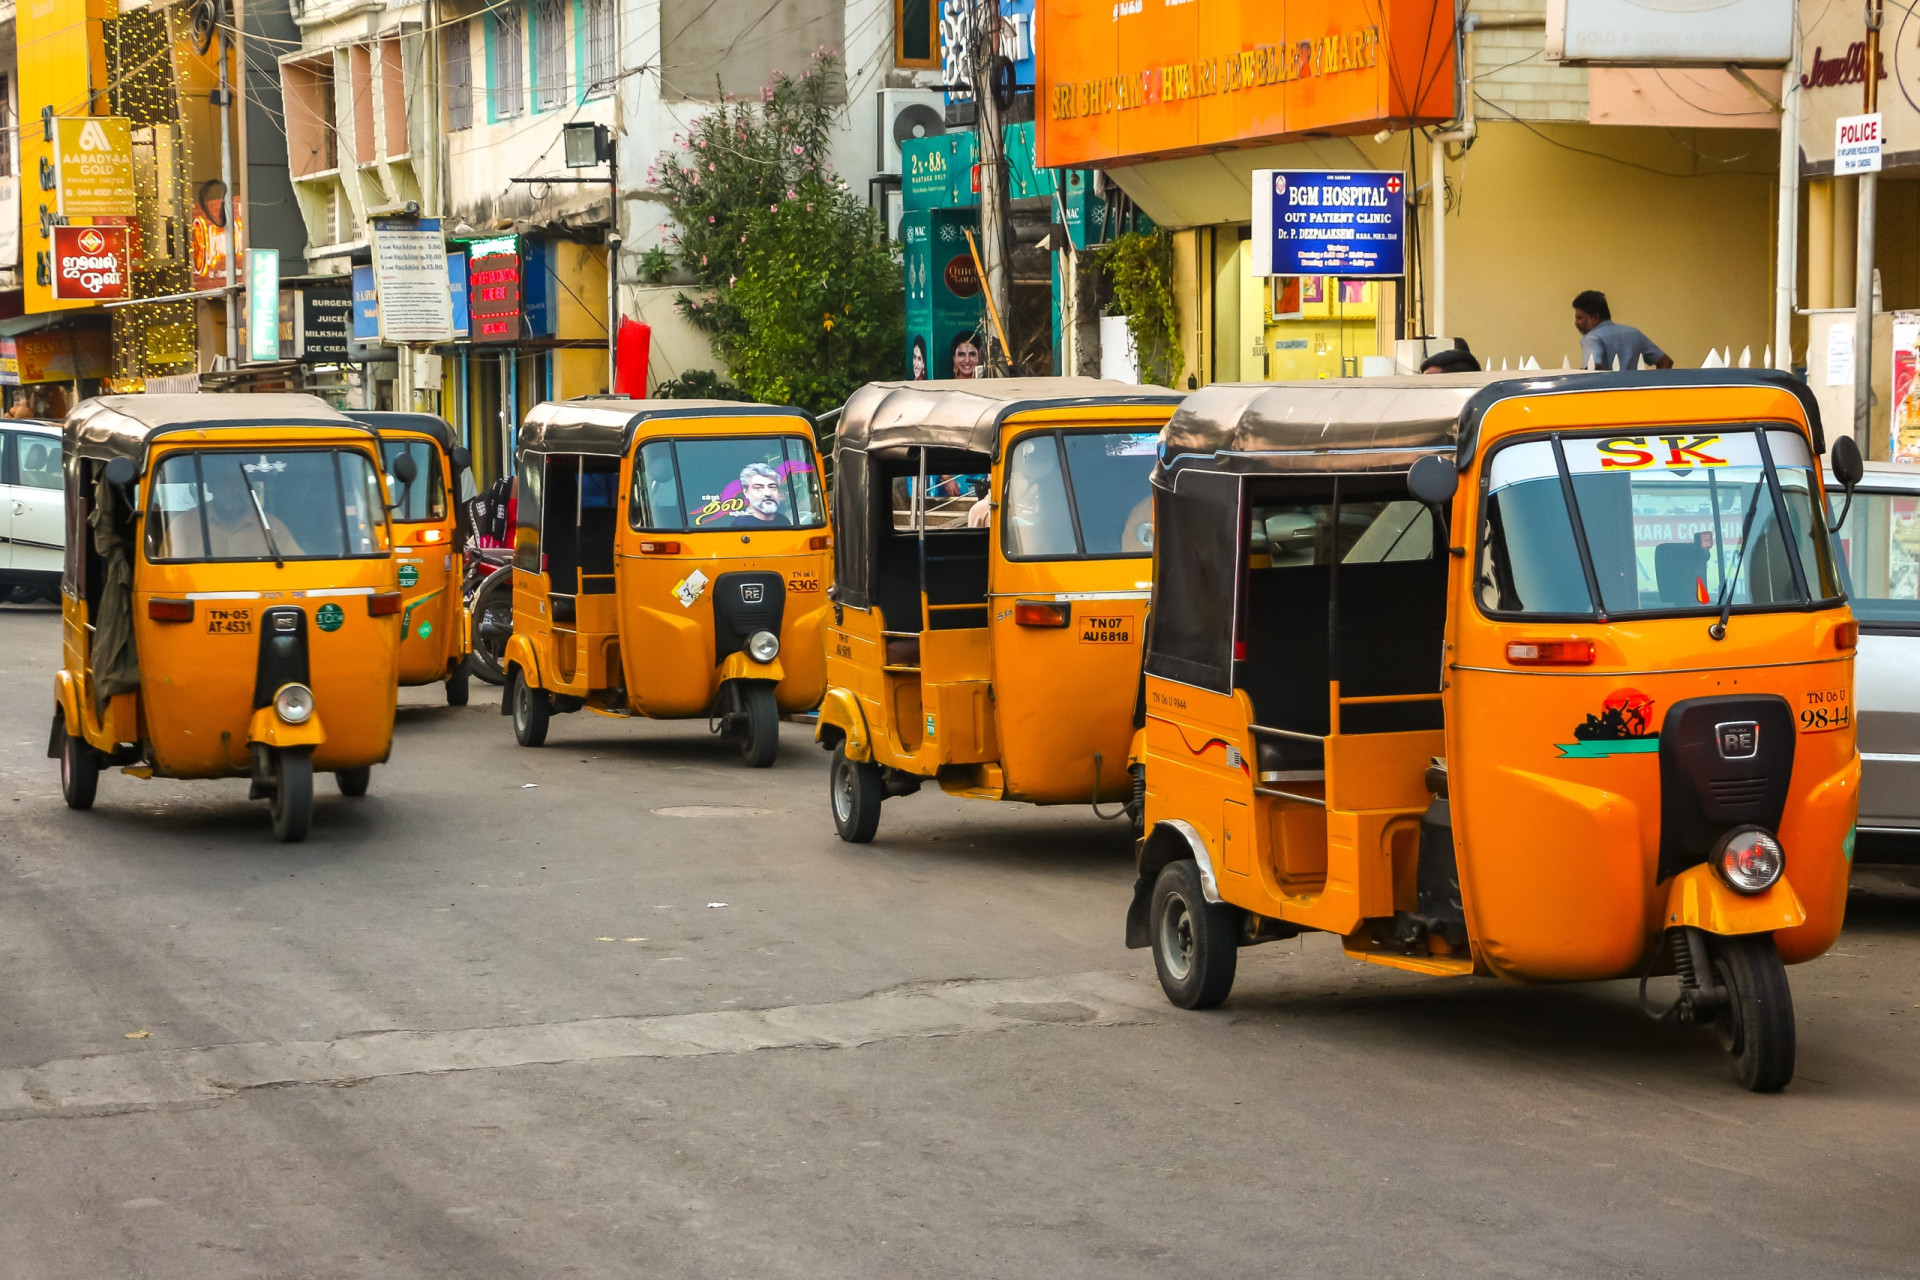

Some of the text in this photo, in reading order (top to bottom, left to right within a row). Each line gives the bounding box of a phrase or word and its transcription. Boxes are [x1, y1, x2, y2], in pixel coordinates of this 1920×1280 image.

[1800, 41, 1888, 89] Jewells
[1052, 83, 1077, 121] SRI
[1324, 26, 1378, 73] MART
[1840, 121, 1877, 144] POLICE
[80, 164, 114, 175] GOLD
[1288, 186, 1388, 207] BGM HOSPITAL
[1066, 207, 1080, 219] NAC
[1284, 212, 1392, 223] OUT PATIENT CLINIC
[914, 226, 926, 236] NAC
[1278, 228, 1289, 239] Dr.
[1290, 229, 1298, 239] P.
[254, 253, 276, 346] HOTEL
[312, 299, 352, 307] BURGERS
[1635, 524, 1673, 541] KARA
[787, 580, 818, 592] 5305
[745, 590, 760, 599] RE
[210, 610, 249, 620] TN-05
[209, 620, 251, 633] AT-4531
[1152, 692, 1161, 702] TN
[1161, 694, 1168, 705] 06
[1168, 696, 1173, 706] U
[1806, 690, 1846, 704] TN 06 U
[1800, 707, 1849, 729] 9844
[1724, 733, 1752, 751] RE
